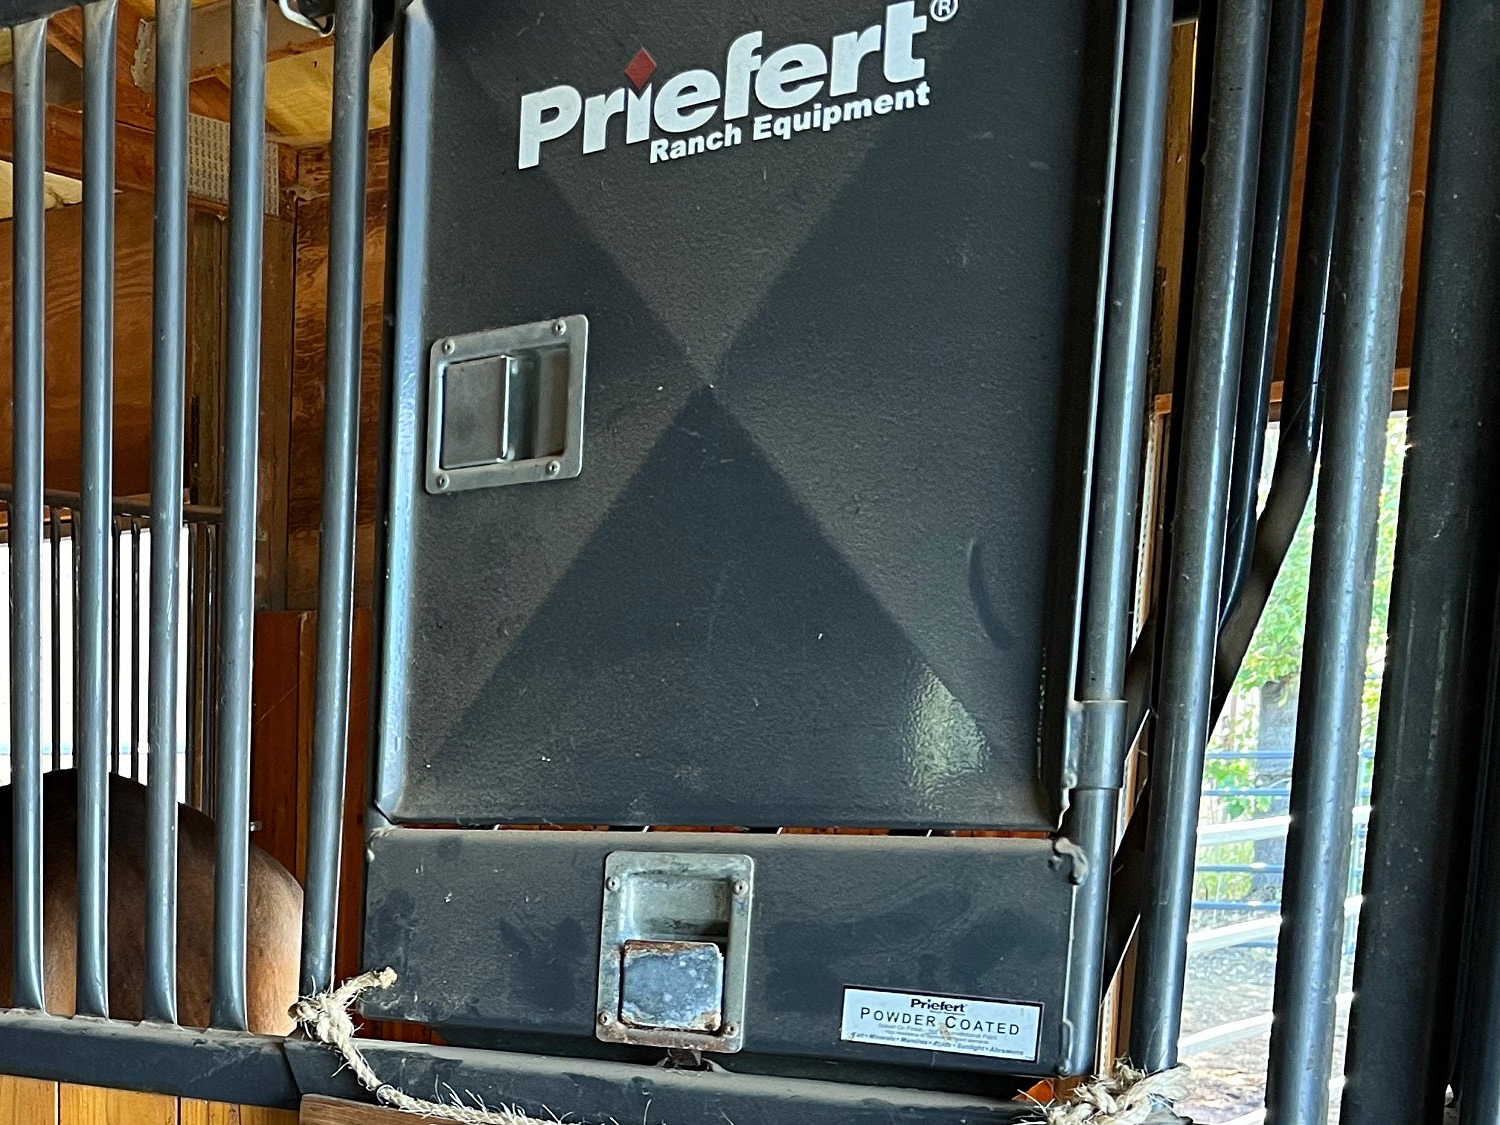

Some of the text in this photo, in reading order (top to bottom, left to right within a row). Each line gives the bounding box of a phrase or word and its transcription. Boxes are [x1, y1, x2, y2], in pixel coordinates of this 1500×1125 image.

[649, 80, 931, 164] Ranch Equipment
[910, 998, 965, 1013] Priefert
[860, 1007, 936, 1028] POWDER
[945, 1015, 1020, 1036] COATED
